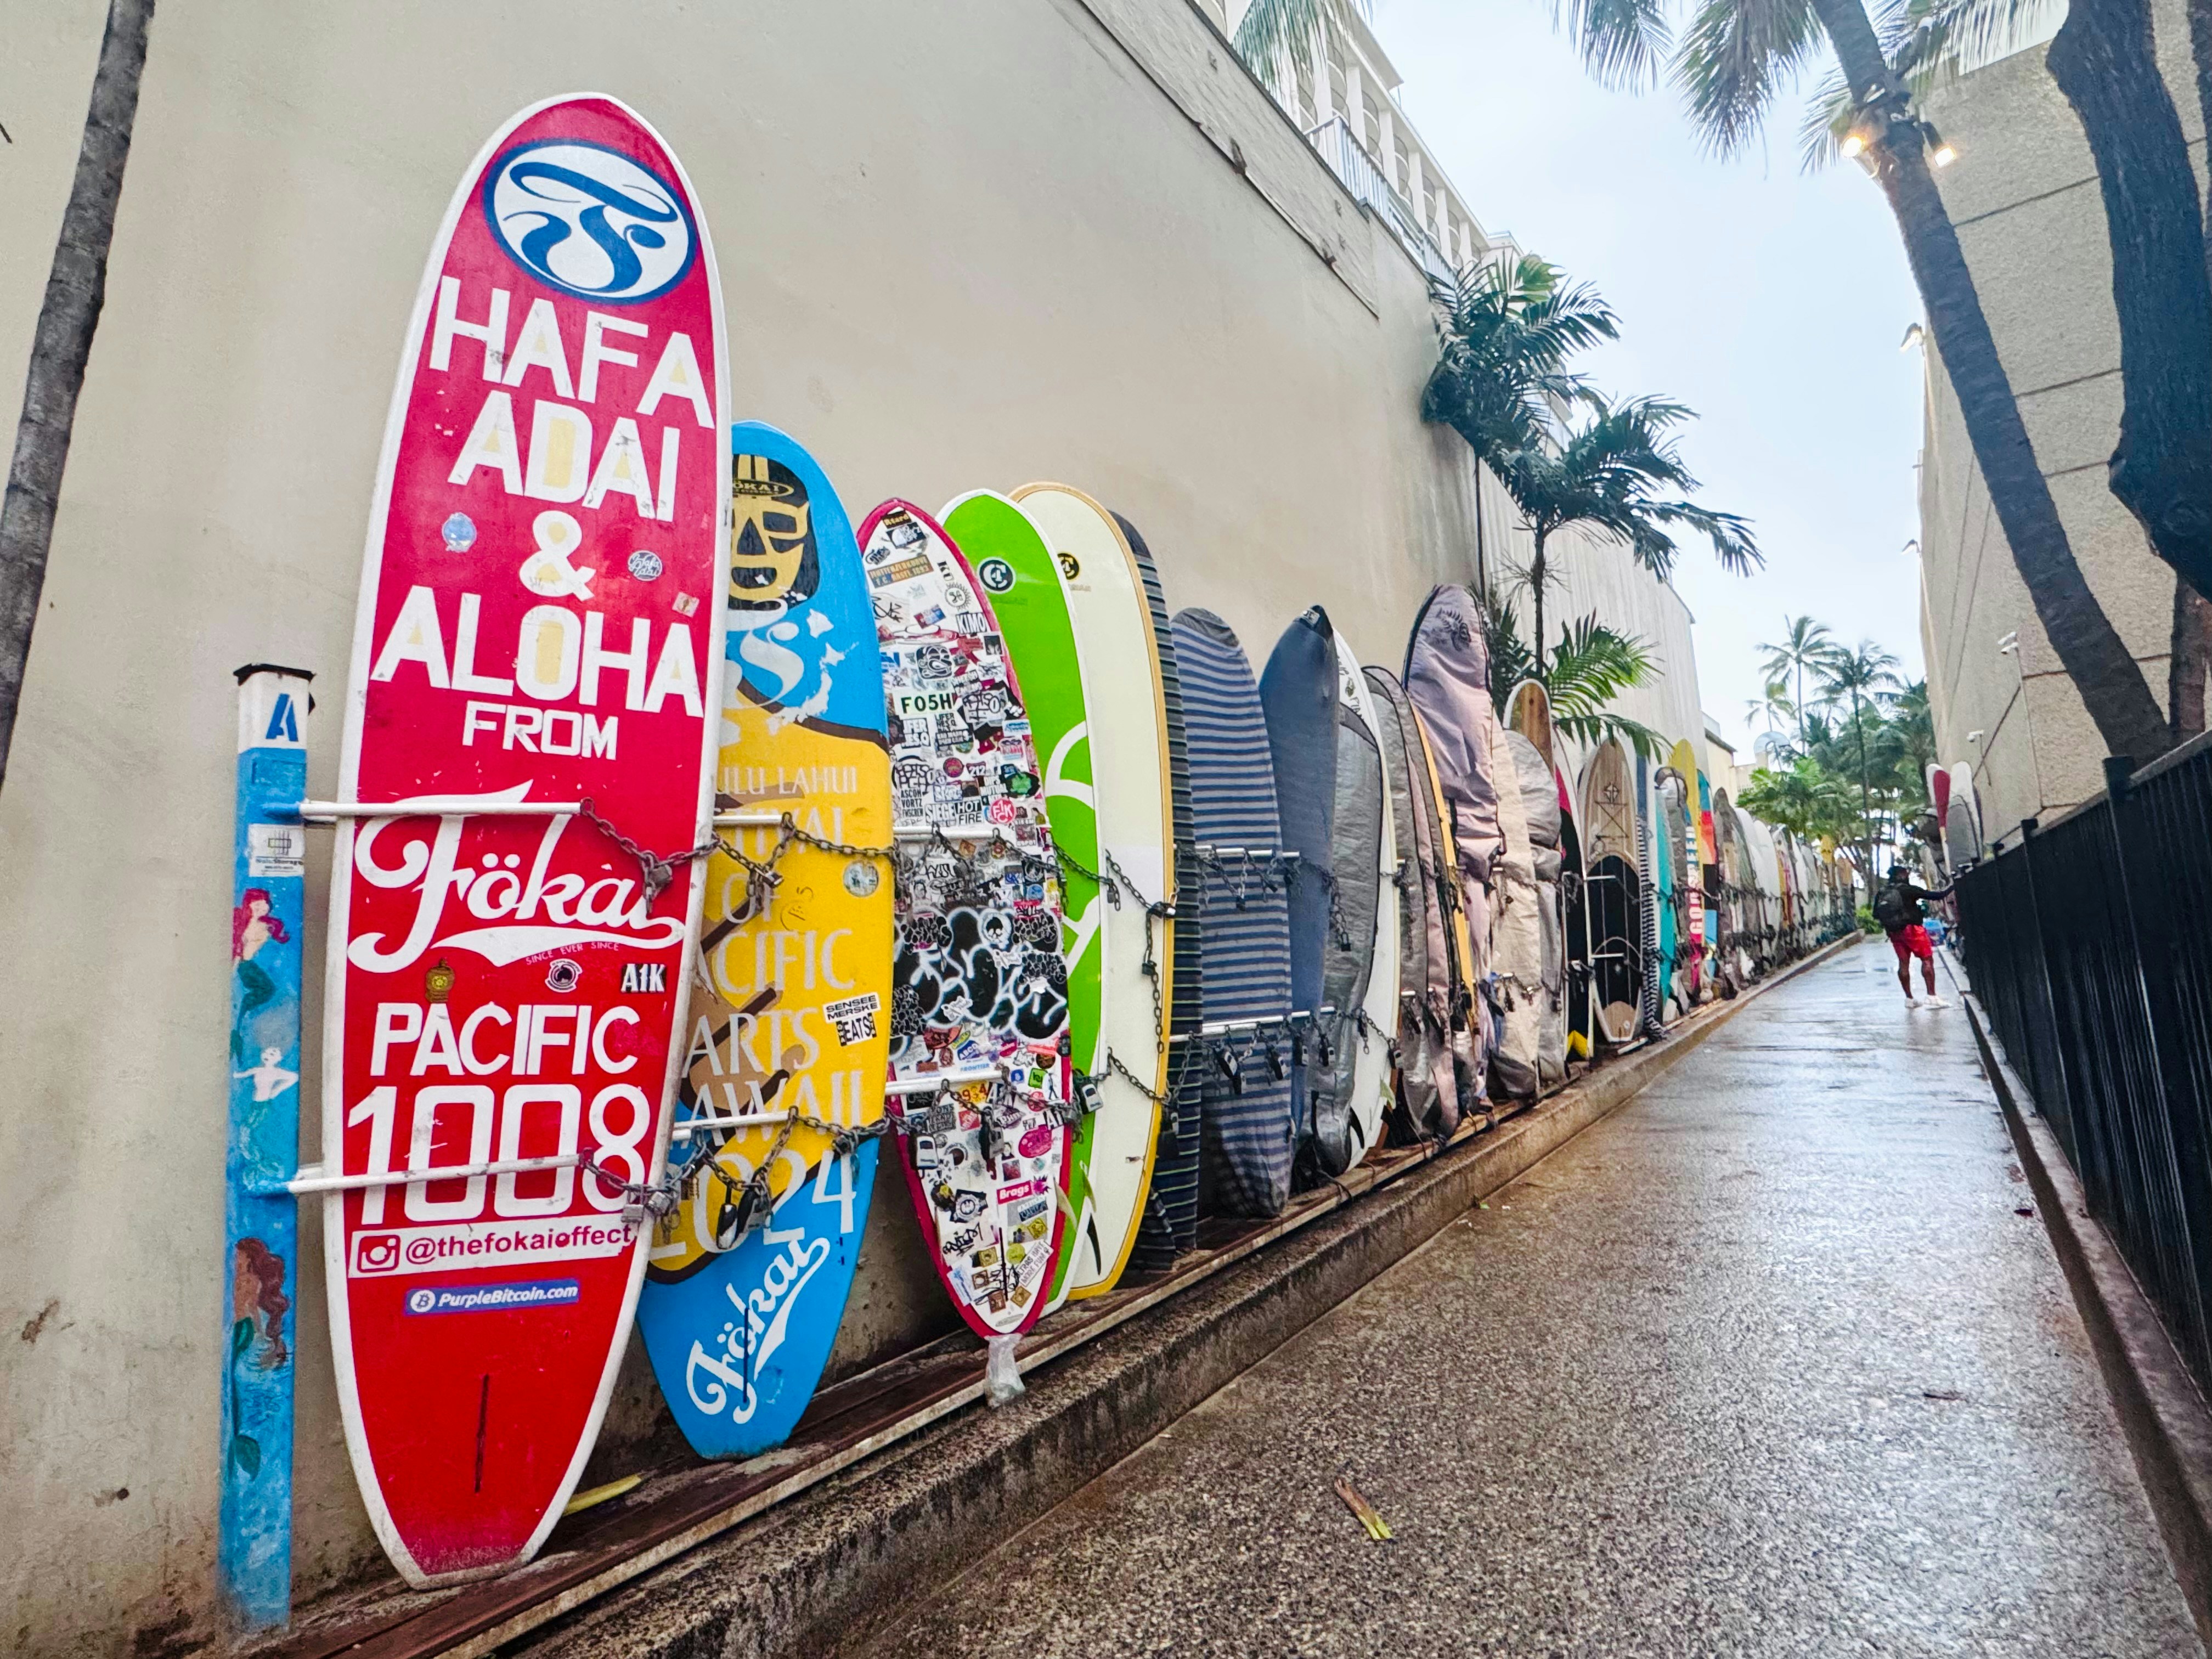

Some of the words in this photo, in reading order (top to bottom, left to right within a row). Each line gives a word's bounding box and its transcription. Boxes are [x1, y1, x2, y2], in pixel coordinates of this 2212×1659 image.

[430, 275, 715, 428] HAFA
[447, 390, 680, 522] ADAI
[519, 510, 596, 601] &
[957, 613, 988, 634] KIMO
[370, 585, 704, 718] ALOHA
[462, 700, 618, 760] FROM
[778, 766, 857, 794] LAHUI
[957, 802, 978, 814] HOT
[960, 813, 982, 823] FIRE
[526, 950, 554, 966] SINCE
[560, 943, 584, 955] EVER
[590, 941, 620, 951] SINCE
[825, 995, 877, 1013] SENSEE
[827, 1002, 879, 1021] MERSKE
[370, 1001, 640, 1076] PACIFIC
[681, 1007, 821, 1079] ARTS
[960, 1063, 990, 1072] FRONTIER
[347, 1084, 651, 1225] 1008
[999, 1183, 1029, 1200] Brags
[437, 1284, 579, 1309] PurpleBitcoin.com
